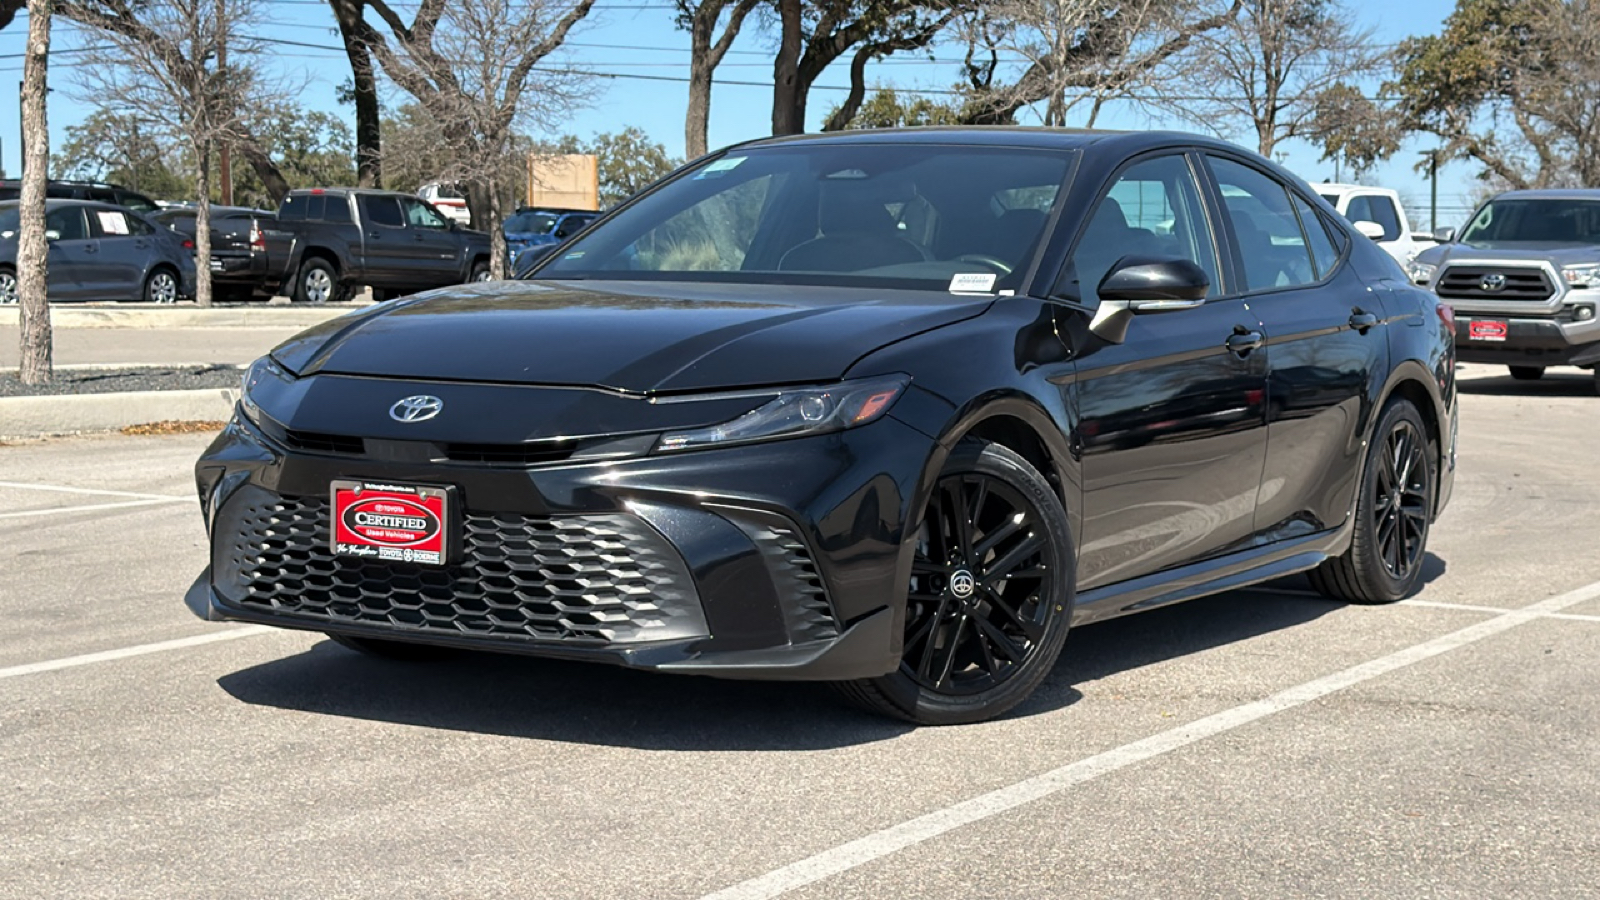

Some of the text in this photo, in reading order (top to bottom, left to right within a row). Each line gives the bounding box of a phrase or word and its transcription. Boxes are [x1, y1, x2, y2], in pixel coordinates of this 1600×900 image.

[384, 505, 405, 513] TOYOTA
[355, 512, 426, 530] CERTIFIED
[366, 529, 415, 540] Used Vehicles
